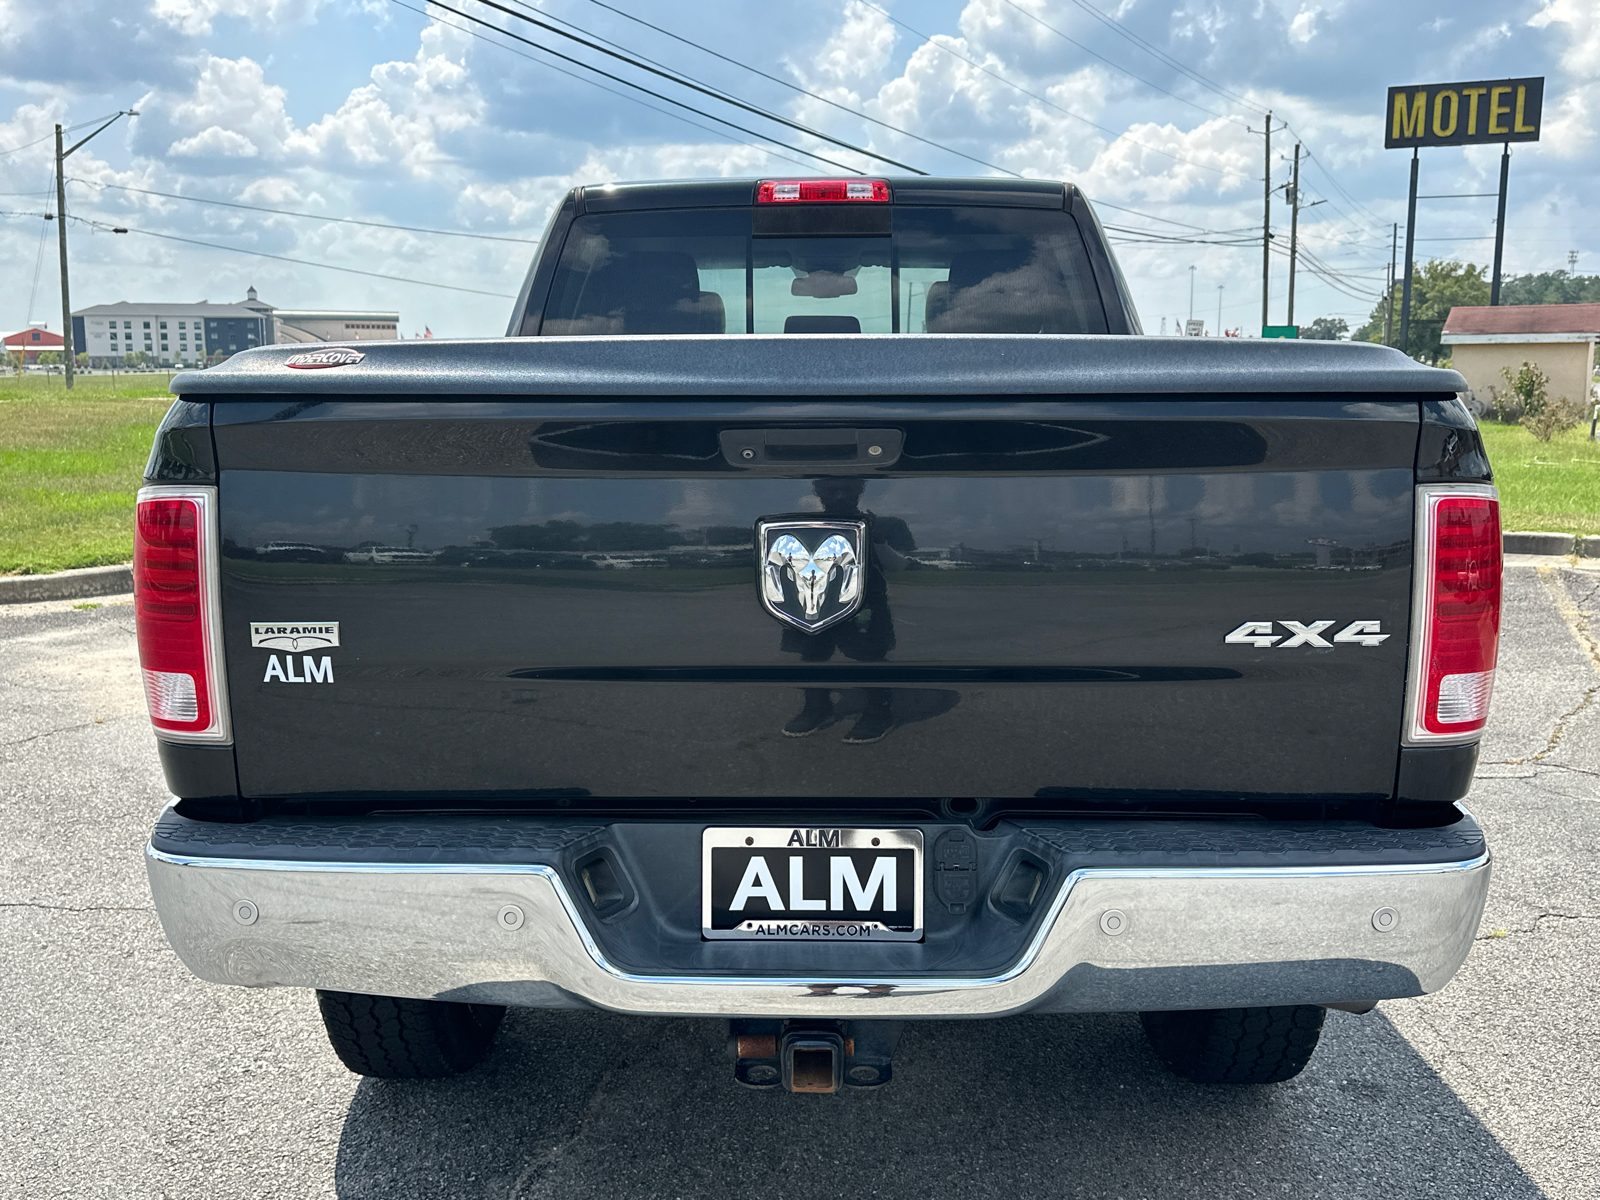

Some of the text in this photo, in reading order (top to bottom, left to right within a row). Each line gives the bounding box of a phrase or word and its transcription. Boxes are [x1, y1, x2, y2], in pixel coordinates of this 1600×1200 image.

[1392, 85, 1535, 139] MOTEL
[254, 626, 334, 634] LARAMIE
[1225, 620, 1391, 648] 4X4
[263, 654, 334, 683] ALM
[787, 829, 840, 847] ALM
[728, 856, 897, 911] ALM
[755, 924, 871, 936] ALMCARS.COM
